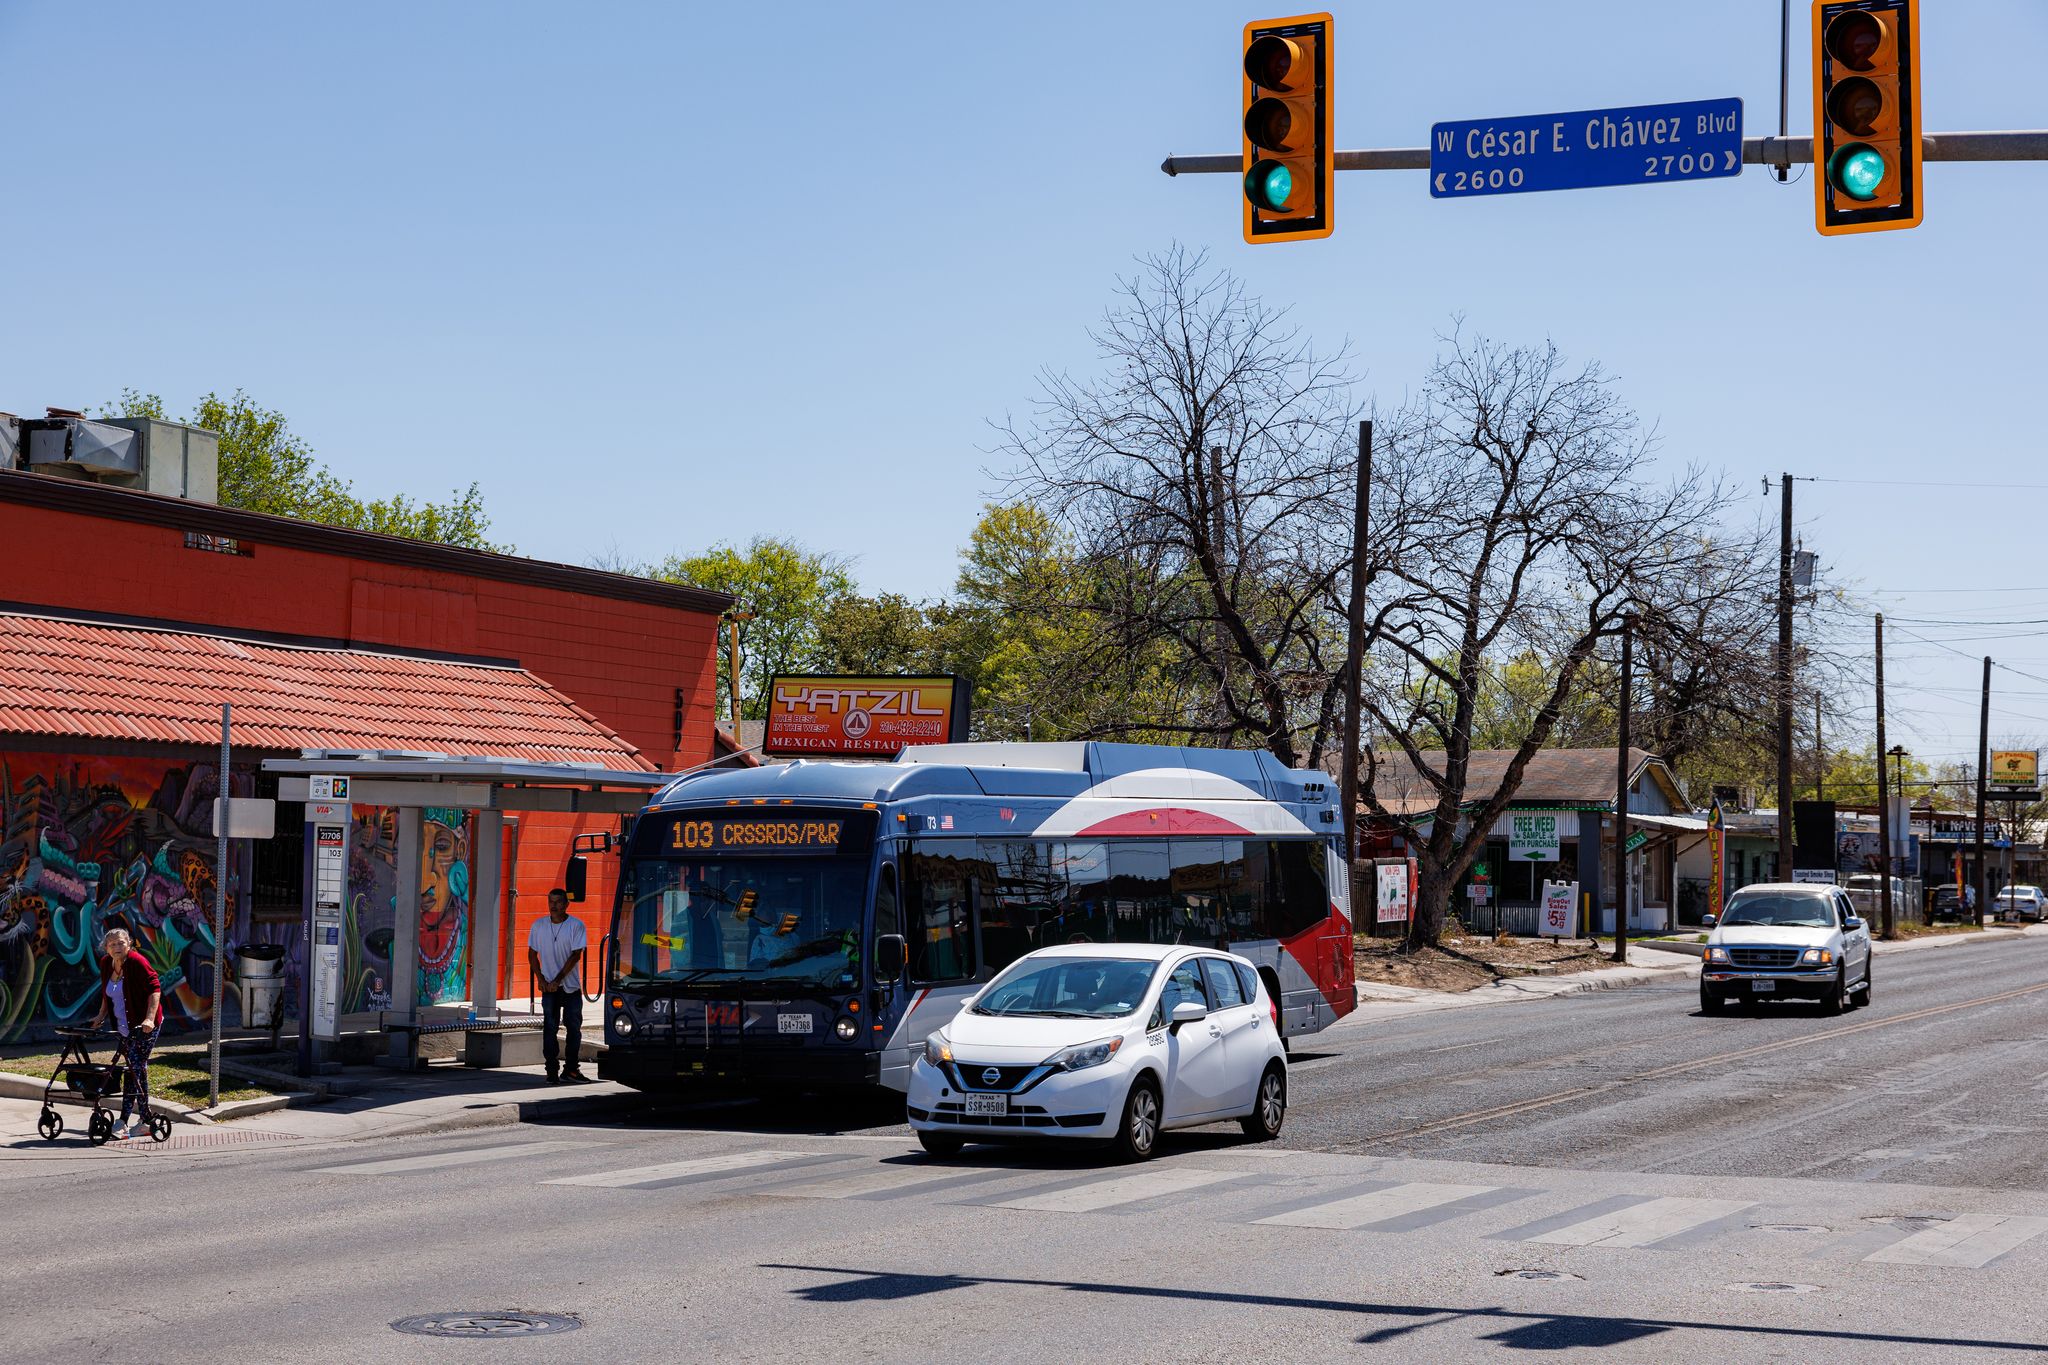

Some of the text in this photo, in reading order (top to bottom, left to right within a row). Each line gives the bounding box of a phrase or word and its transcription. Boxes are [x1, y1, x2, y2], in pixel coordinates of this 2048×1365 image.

[1438, 111, 1736, 160] W César E. Chávez Blvd
[1454, 152, 1715, 191] 2600 2700
[776, 687, 944, 715] YATZIL
[774, 714, 817, 723] THE BEST
[772, 723, 829, 733] IN THE WEST
[771, 738, 837, 748] MEXICAN
[316, 806, 329, 814] VIA
[1513, 816, 1555, 831] FREE WEED
[320, 832, 341, 840] 21706
[672, 821, 840, 848] 103 CRSSRDS/P&R
[1510, 840, 1558, 848] WITH PURCHASE
[329, 849, 342, 857] 103
